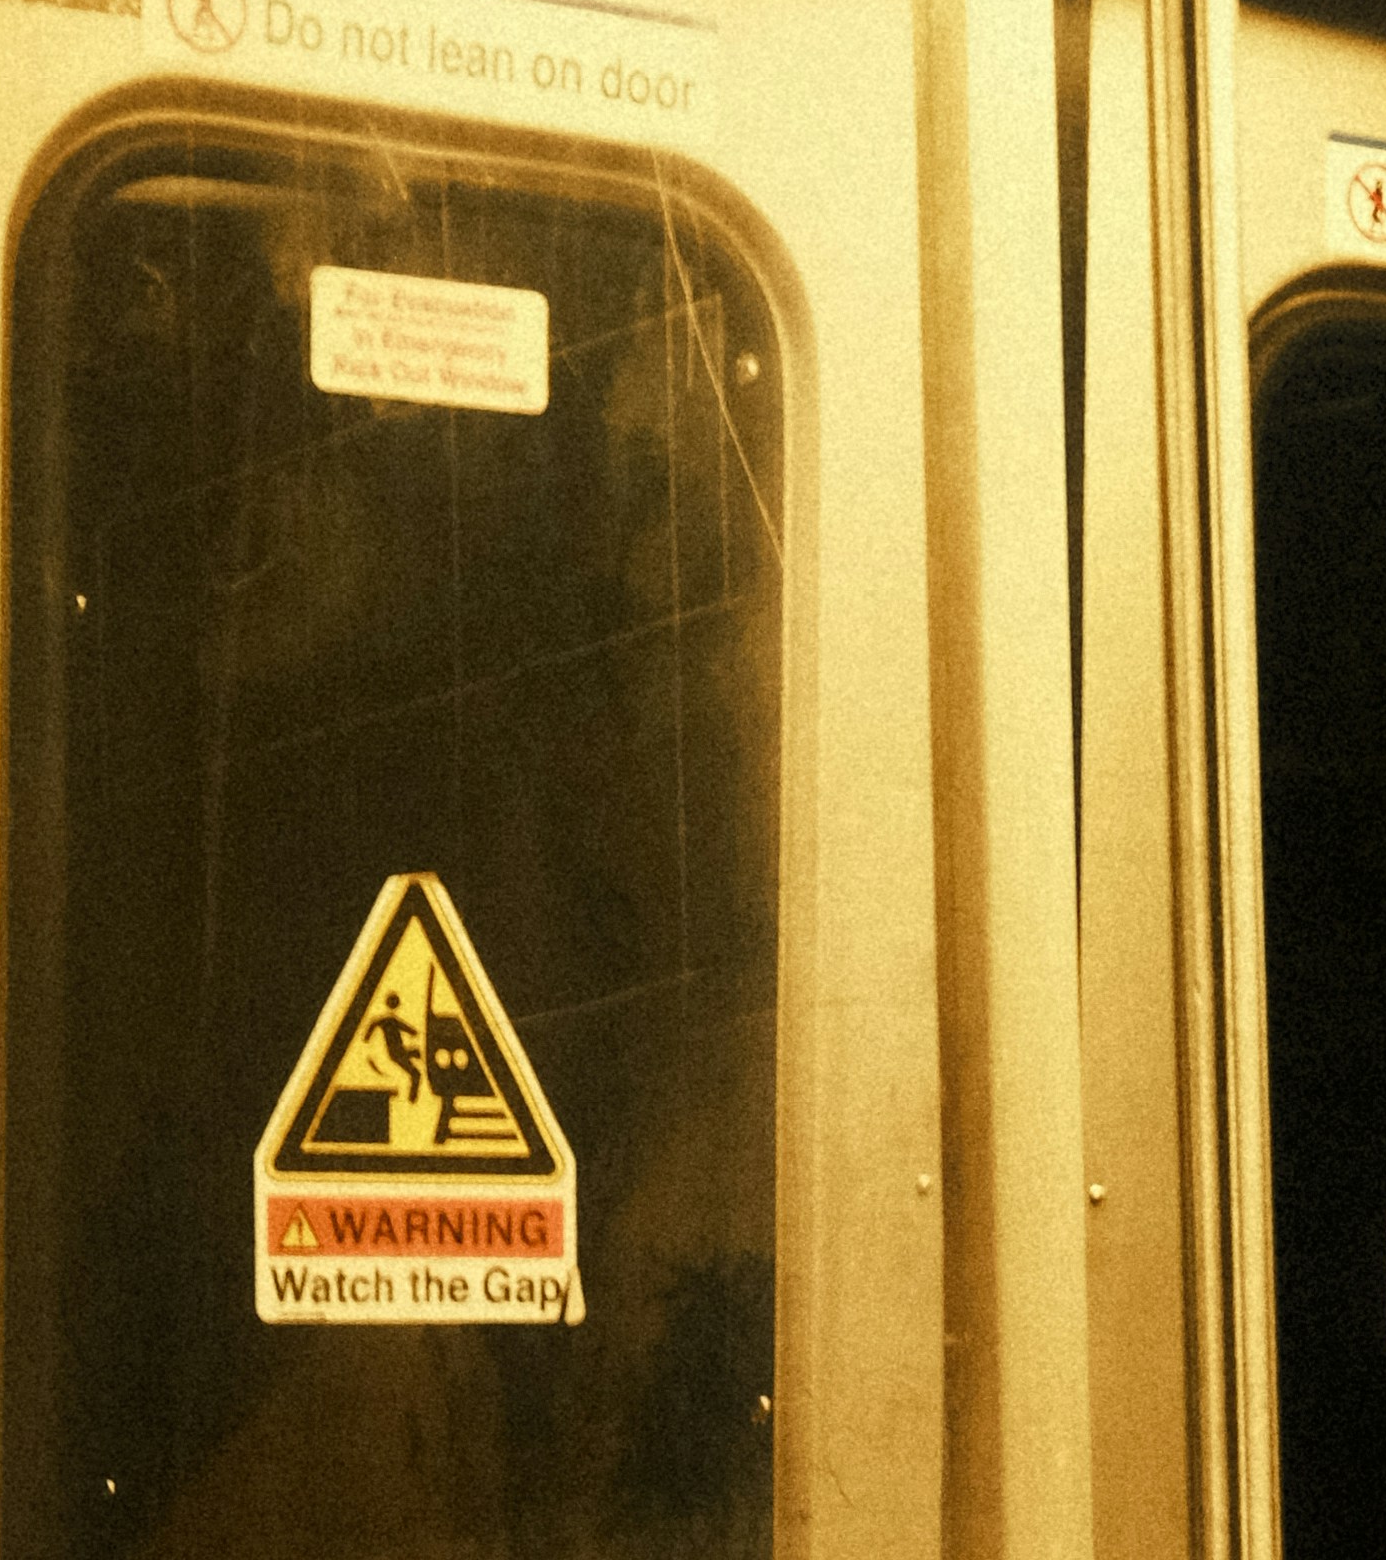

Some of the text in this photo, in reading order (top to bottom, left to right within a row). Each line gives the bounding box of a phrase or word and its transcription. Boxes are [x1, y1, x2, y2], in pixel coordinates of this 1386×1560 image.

[341, 20, 410, 67] not
[426, 25, 515, 83] lean
[531, 52, 583, 93] on
[599, 59, 696, 111] door
[328, 1206, 550, 1248] WARNING
[270, 1265, 563, 1312] Watch the Gap
